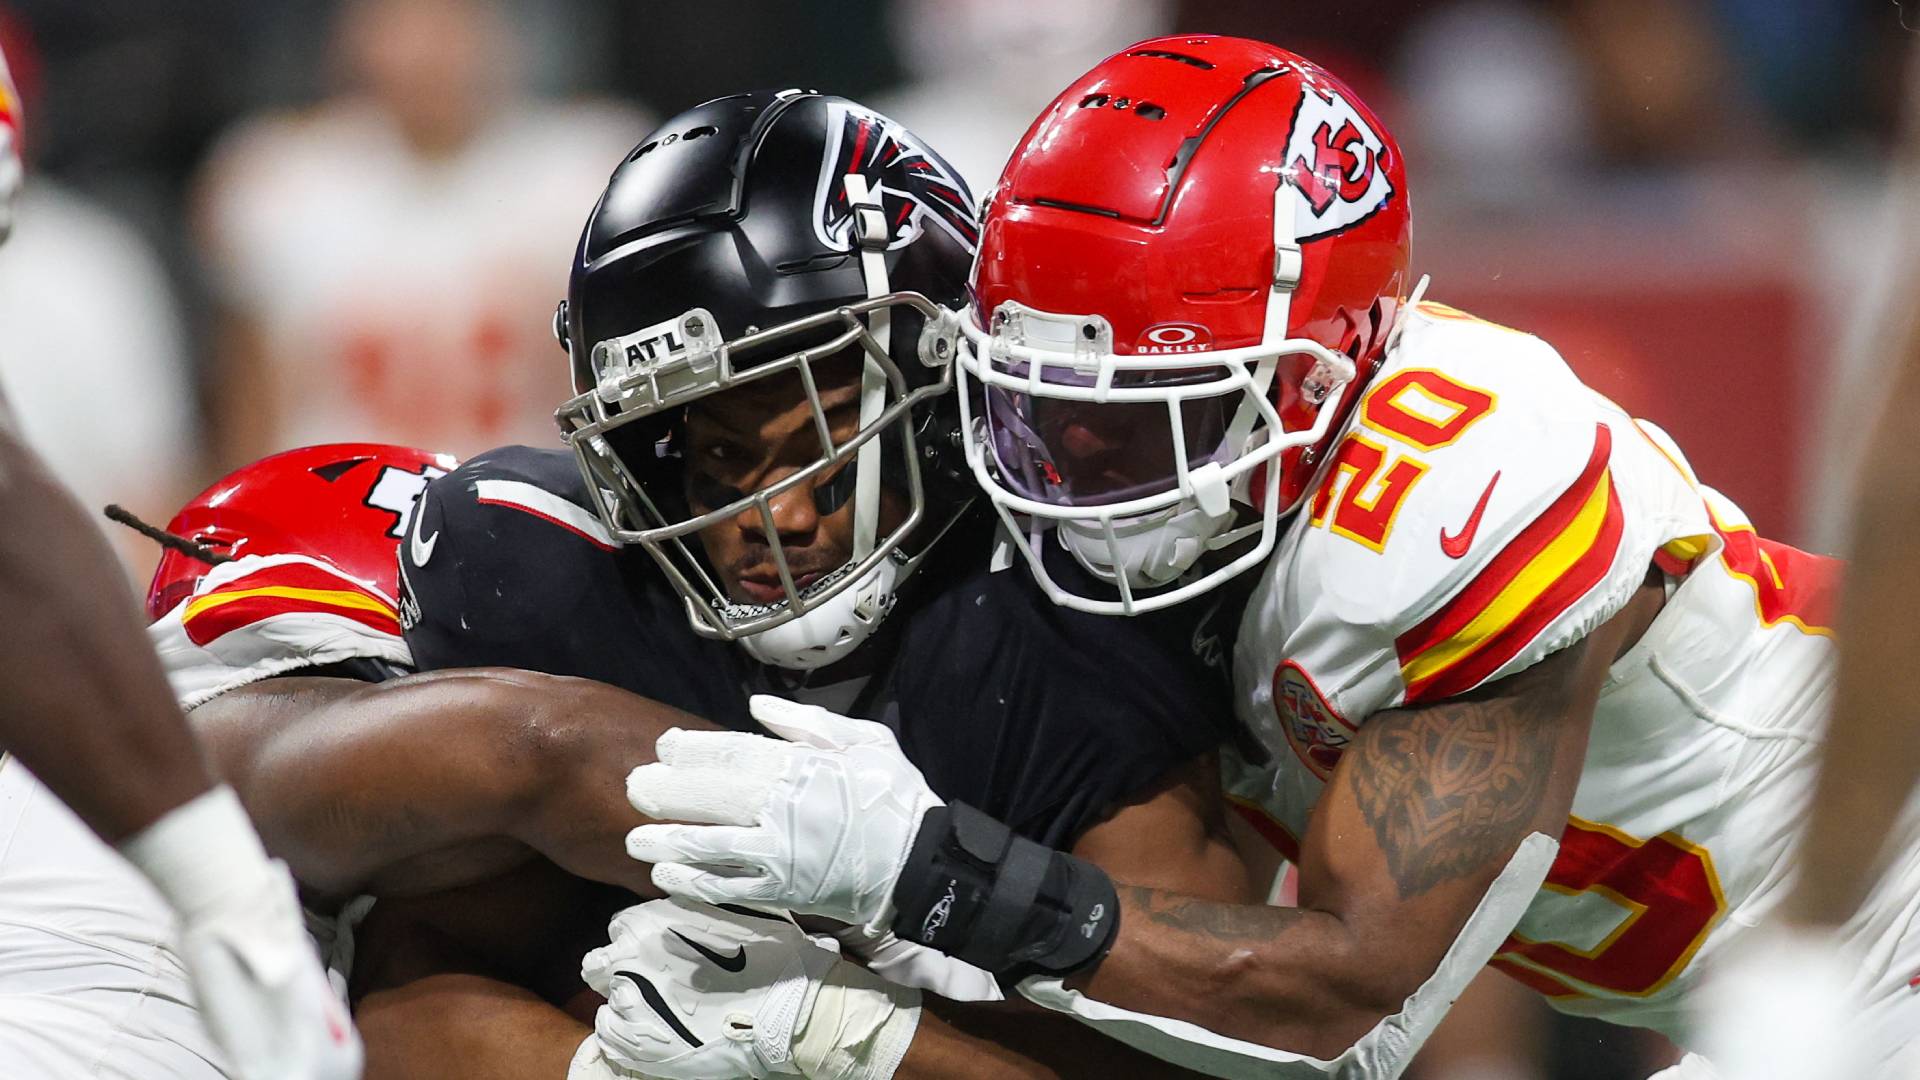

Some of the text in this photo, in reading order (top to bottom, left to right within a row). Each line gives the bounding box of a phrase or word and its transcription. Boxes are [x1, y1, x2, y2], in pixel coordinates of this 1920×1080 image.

[1287, 117, 1375, 219] KC
[625, 332, 685, 367] ATL
[1137, 344, 1207, 354] OAKLEY
[1308, 366, 1499, 555] 20
